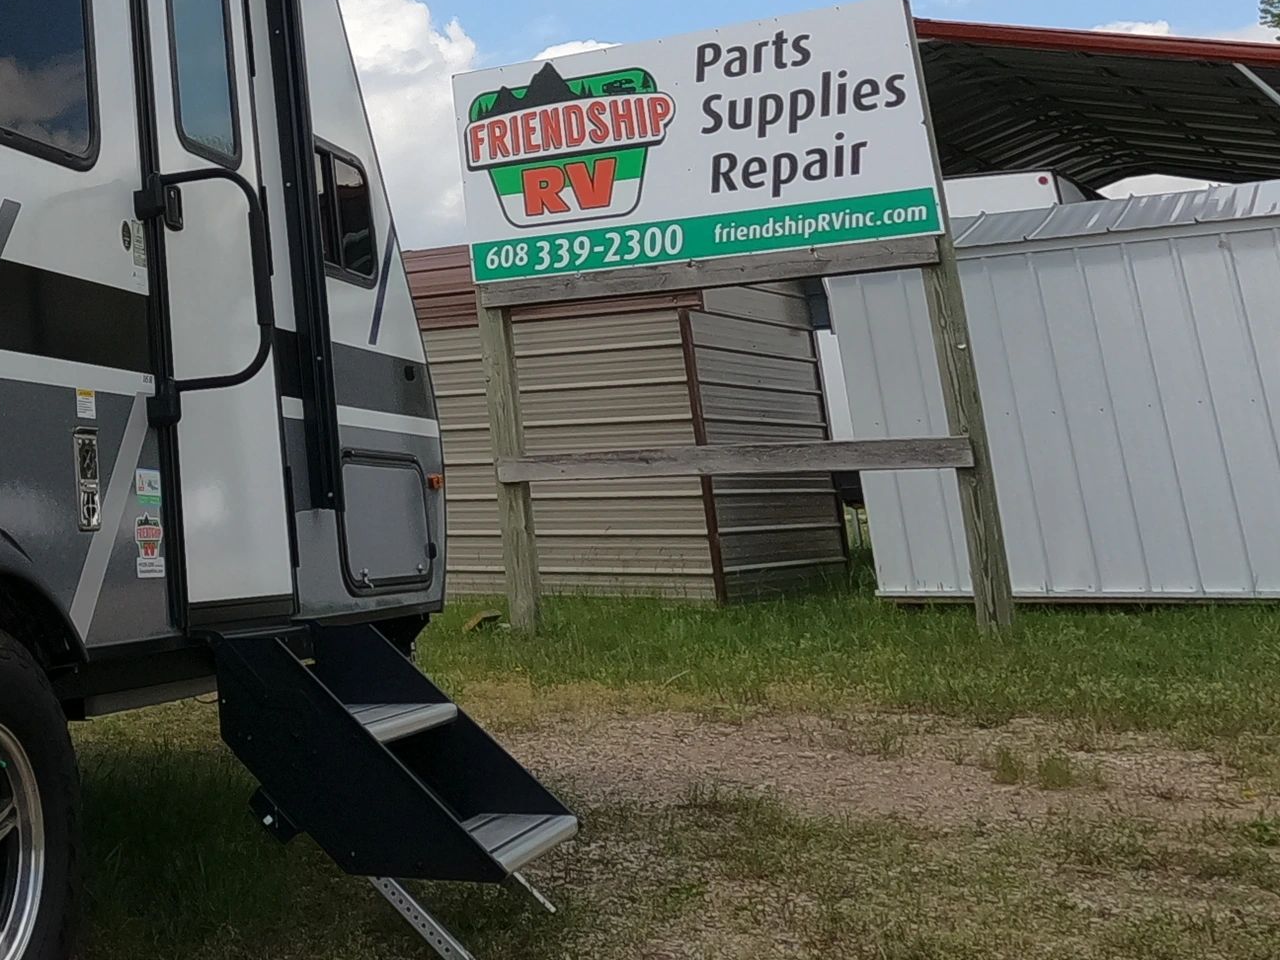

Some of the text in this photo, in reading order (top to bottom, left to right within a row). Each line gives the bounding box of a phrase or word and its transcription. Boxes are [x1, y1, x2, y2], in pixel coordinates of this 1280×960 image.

[695, 30, 812, 83] Parts
[468, 95, 673, 164] FRIENDSHIP
[700, 69, 907, 138] Supplies
[520, 157, 617, 217] RV
[711, 132, 868, 197] Repair
[484, 223, 684, 271] 608 339-2300
[713, 201, 928, 244] friendshipRVinc.com
